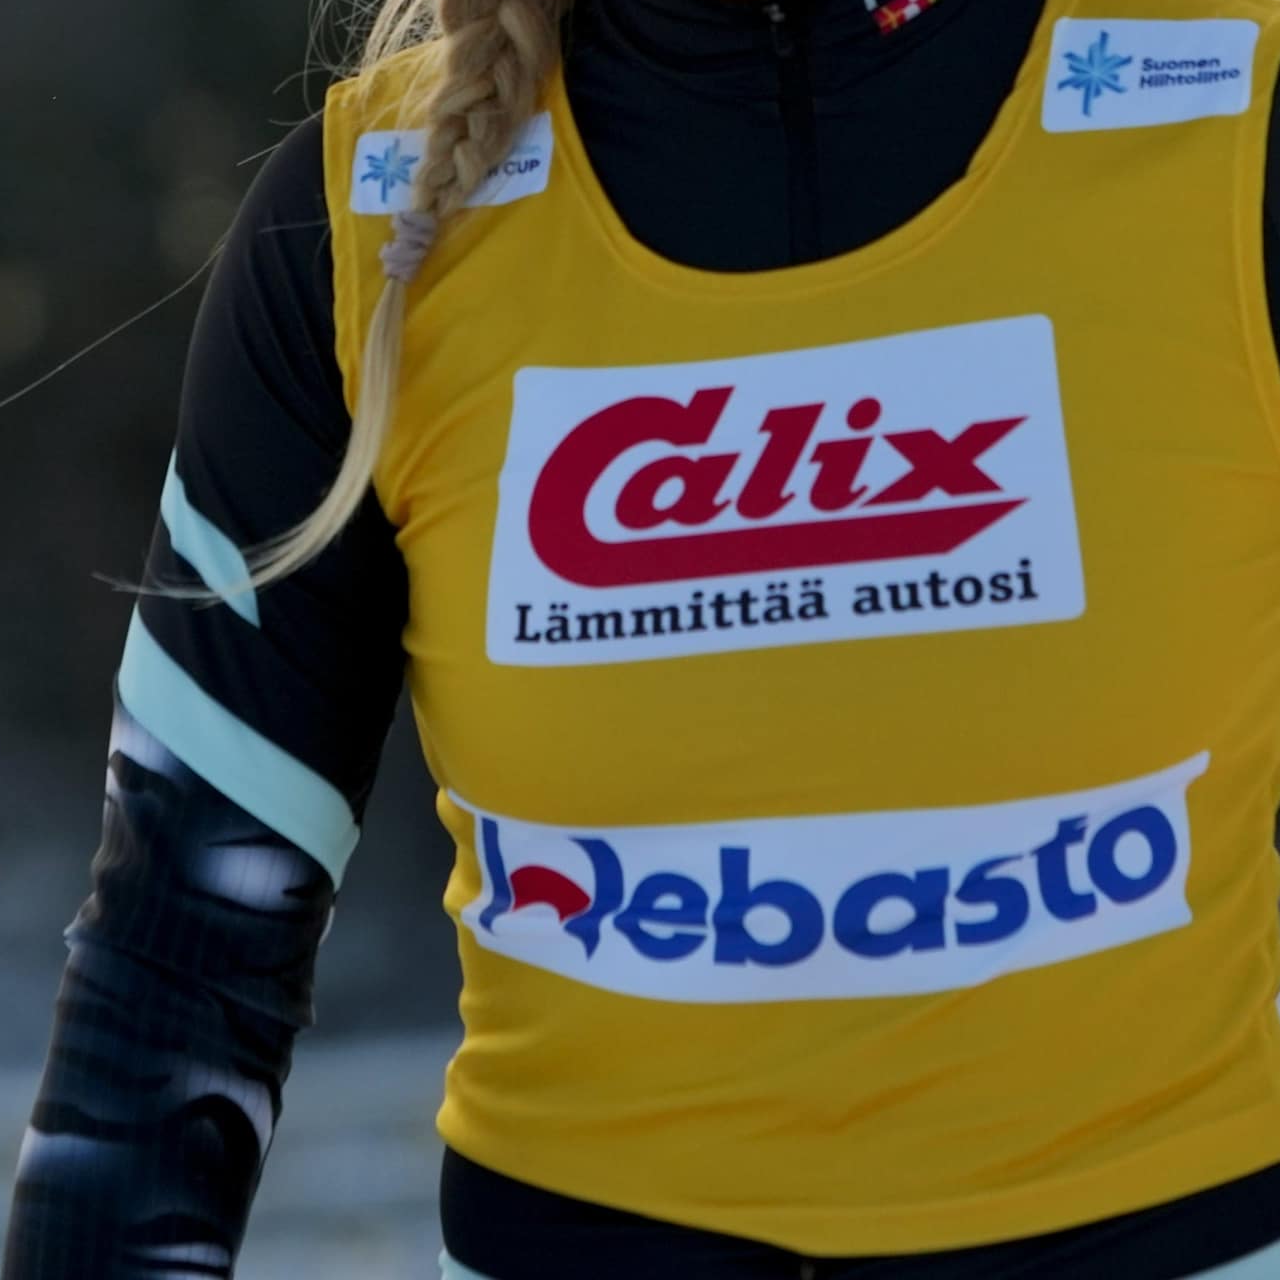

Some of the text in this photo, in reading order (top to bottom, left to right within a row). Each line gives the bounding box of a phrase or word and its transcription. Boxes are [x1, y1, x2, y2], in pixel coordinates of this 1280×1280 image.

[1142, 57, 1220, 72] Suomen
[503, 158, 541, 176] CUP
[528, 385, 1030, 589] Calix
[515, 558, 1039, 644] Lämmittää autosi
[479, 805, 1178, 969] Webasto
